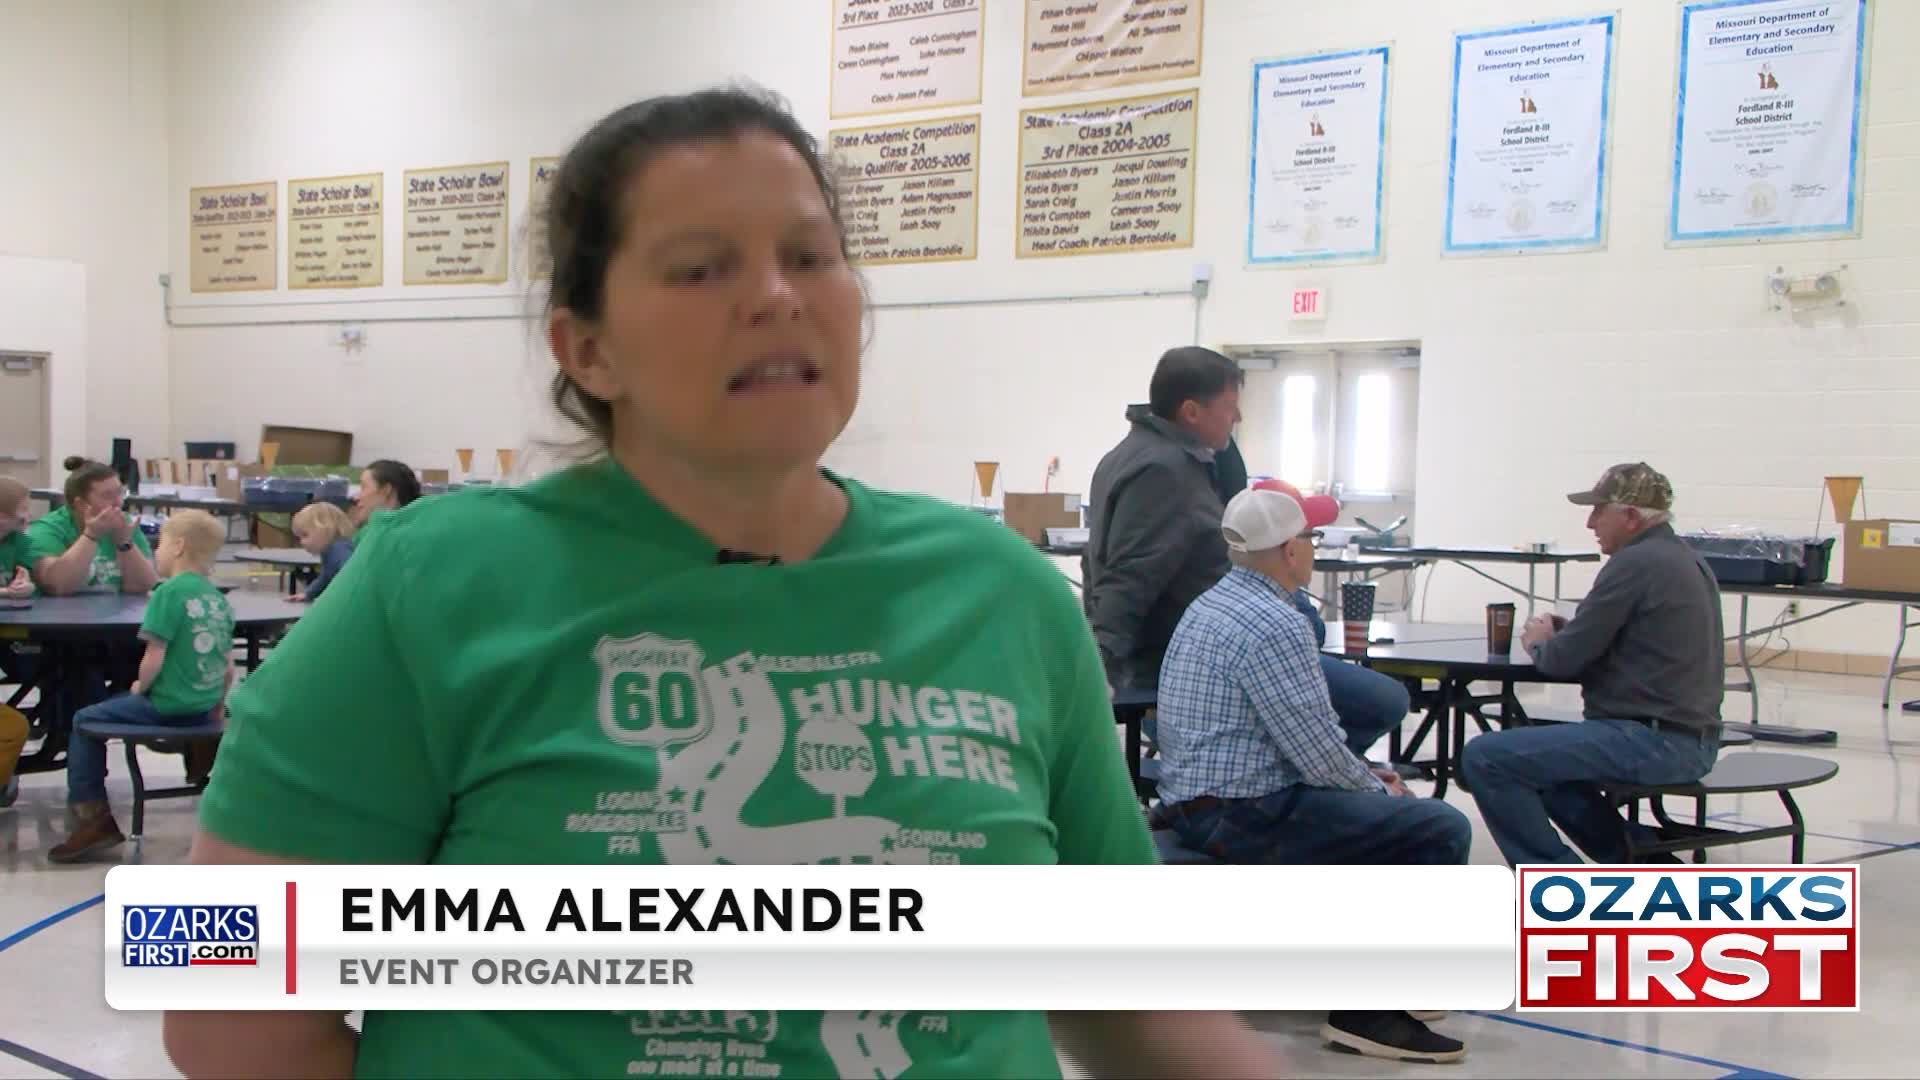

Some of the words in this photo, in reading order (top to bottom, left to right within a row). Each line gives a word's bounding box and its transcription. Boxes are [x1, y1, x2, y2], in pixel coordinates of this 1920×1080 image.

[858, 11, 878, 21] Place
[1716, 16, 1756, 30] Missouri
[1759, 11, 1816, 25] Department
[1819, 8, 1829, 17] of
[910, 36, 928, 45] Caleb
[932, 30, 976, 42] Cunningham
[1709, 31, 1760, 45] Elementary
[1763, 29, 1781, 39] and
[1784, 23, 1835, 37] Secondary
[1484, 46, 1519, 57] Missouri
[1521, 41, 1569, 54] Department
[1746, 44, 1793, 56] Education
[860, 55, 899, 67] Cunningham
[1478, 59, 1522, 72] Elementary
[1525, 57, 1540, 66] and
[1543, 53, 1585, 65] Secondary
[1310, 70, 1351, 82] Department
[1509, 72, 1550, 83] Education
[1273, 88, 1311, 98] Elementary
[1329, 81, 1365, 92] Secondary
[1301, 98, 1335, 108] Education
[1738, 103, 1774, 114] Fordland
[1024, 116, 1053, 129] State
[1736, 116, 1761, 126] School
[1764, 113, 1792, 123] District
[834, 136, 859, 148] State
[861, 130, 909, 144] Academic
[913, 123, 975, 140] Competition
[1079, 126, 1111, 139] Class
[1116, 122, 1132, 136] 2A
[1503, 125, 1532, 135] Fordland
[1042, 146, 1062, 160] 3rd
[1067, 144, 1098, 158] Place
[1101, 134, 1171, 154] 2004-2005
[1501, 137, 1522, 146] School
[1525, 136, 1549, 144] District
[880, 146, 907, 158] Class
[911, 143, 925, 155] 2A
[865, 162, 908, 176] Qualifier
[911, 154, 970, 169] 2005-2006
[1147, 157, 1188, 169] Dowling
[1024, 170, 1068, 181] Elizabeth
[1070, 167, 1098, 179] Byers
[1142, 173, 1175, 185] Killam
[409, 178, 435, 193] State
[438, 176, 476, 191] Scholar
[479, 171, 504, 187] Bowl
[1024, 185, 1048, 195] Katie
[1051, 183, 1078, 194] Byers
[298, 189, 319, 203] State
[321, 186, 351, 201] Scholar
[354, 184, 373, 199] Bowl
[901, 194, 924, 204] Adam
[1113, 190, 1141, 202] Justin
[1145, 187, 1176, 198] Morris
[1025, 198, 1049, 208] Sarah
[1053, 196, 1076, 208] Craig
[857, 211, 878, 221] Craig
[901, 208, 926, 217] Justin
[928, 205, 955, 214] Morris
[1111, 205, 1153, 216] Cameron
[1024, 213, 1046, 223] Mark
[1110, 220, 1132, 230] Leah
[1052, 224, 1079, 234] Davis
[1032, 240, 1056, 250] Head
[1092, 236, 1126, 247] Patrick
[891, 248, 920, 257] Patrick
[1294, 291, 1319, 313] EXIT
[610, 671, 699, 732] 60
[791, 679, 1022, 744] HUNGER
[799, 741, 874, 774] STOPS
[890, 736, 1019, 793] HERE
[607, 836, 641, 855] FFA
[896, 828, 987, 849] FORDLAND
[918, 1016, 948, 1033] FFA
